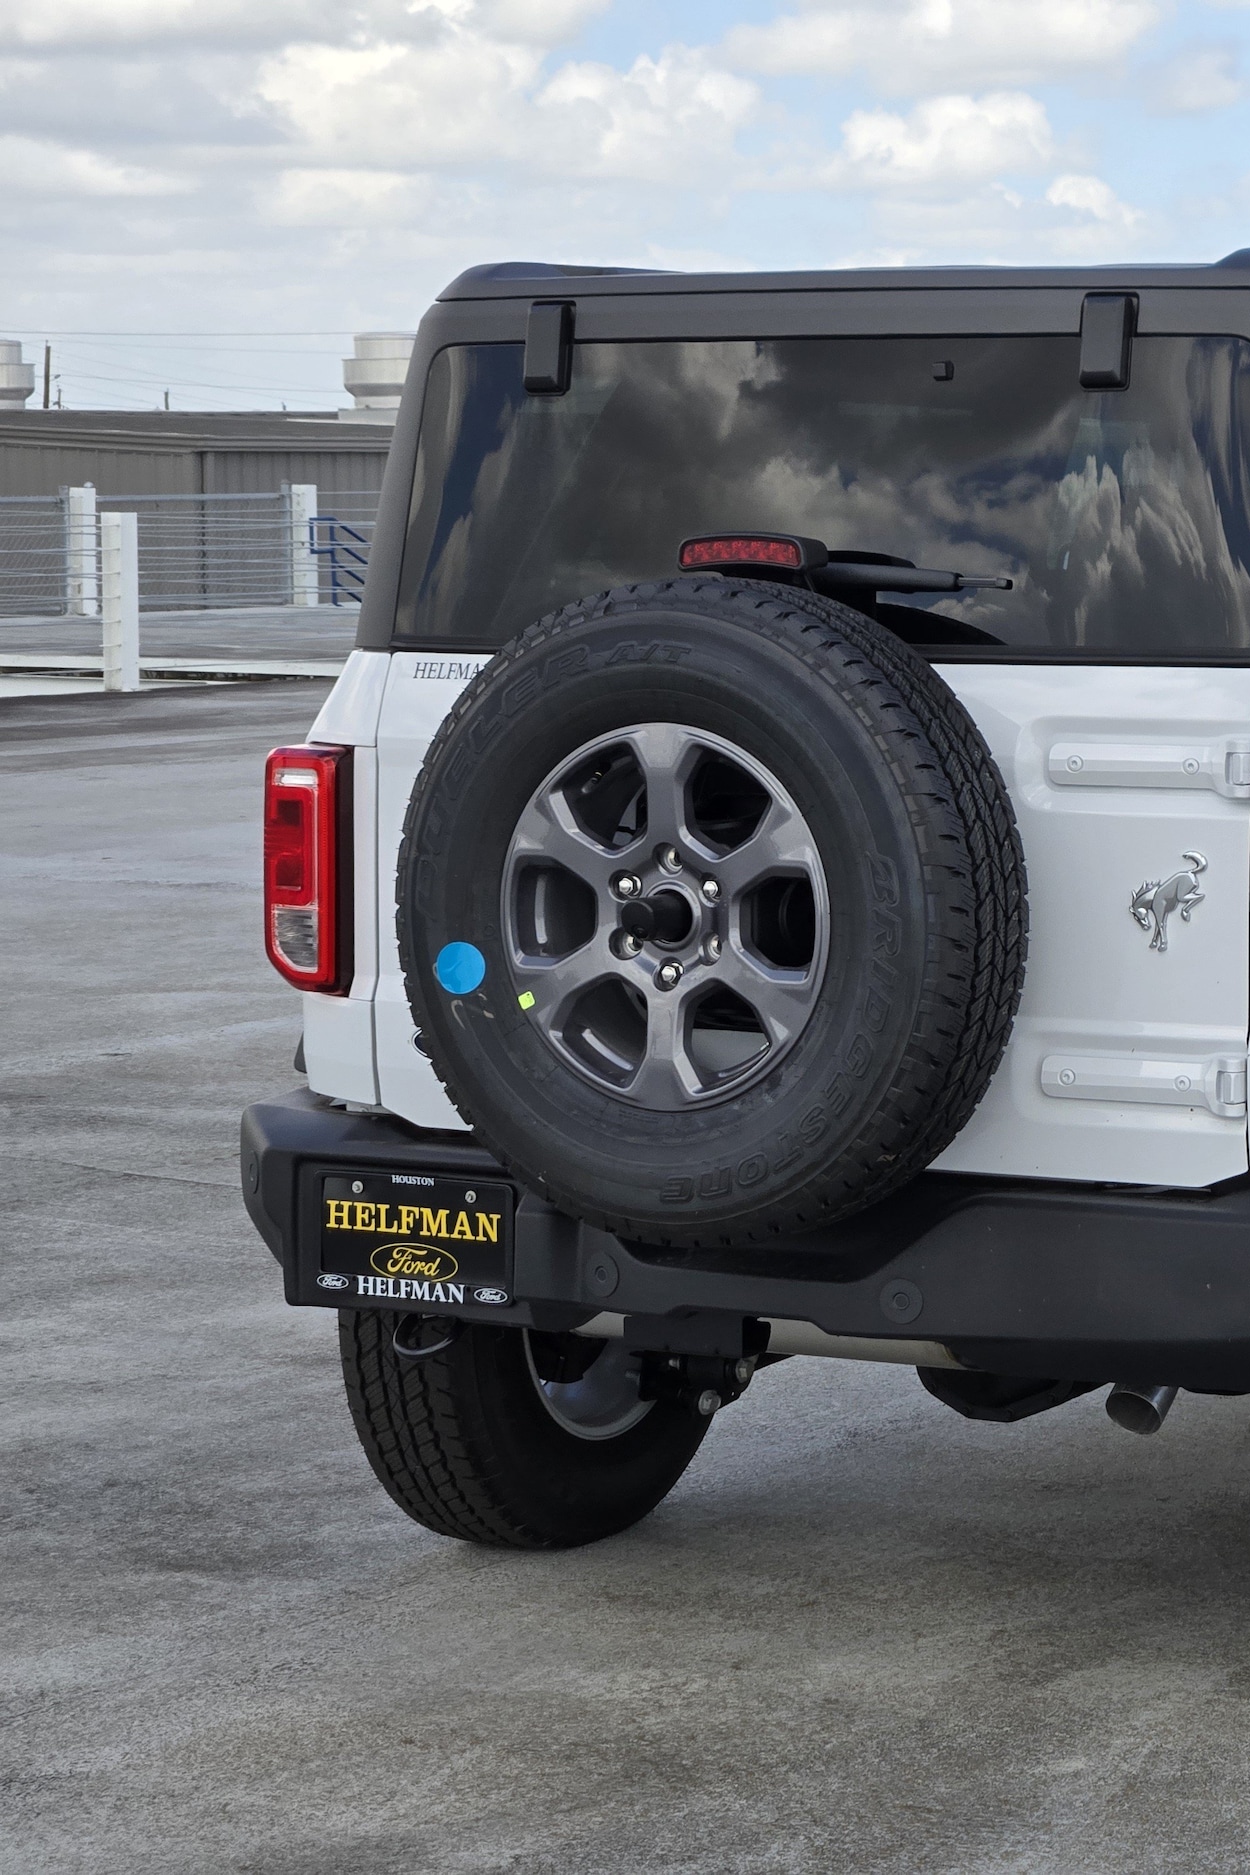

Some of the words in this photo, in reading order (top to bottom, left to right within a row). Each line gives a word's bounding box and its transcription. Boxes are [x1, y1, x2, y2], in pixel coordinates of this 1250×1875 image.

[606, 640, 692, 667] A/T
[413, 662, 482, 680] HELFMA
[659, 850, 901, 1204] BRIDGESTONE
[391, 1174, 435, 1187] HOUSTON
[325, 1199, 501, 1242] HELFMAN
[386, 1245, 441, 1279] Ford
[356, 1275, 465, 1304] HELFMAN
